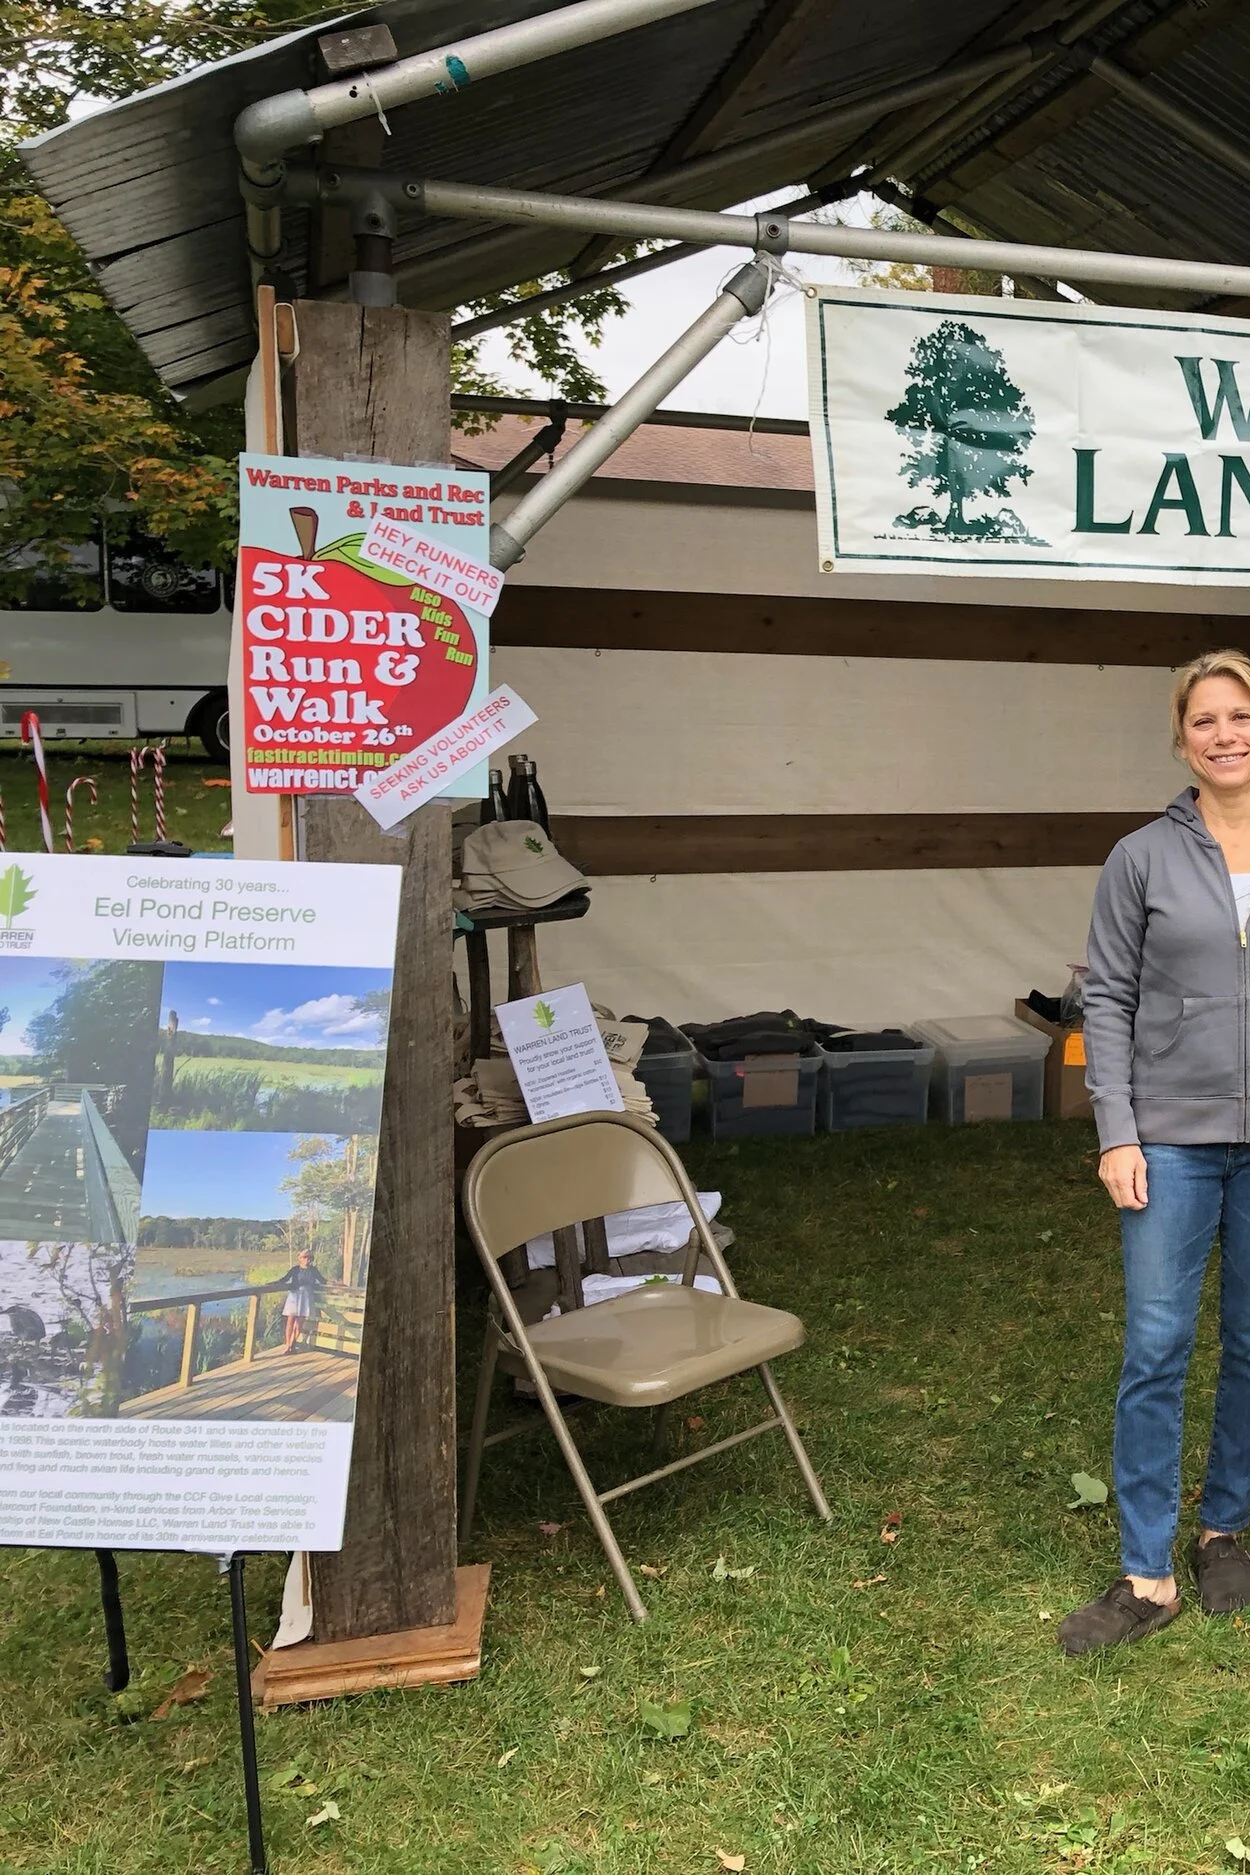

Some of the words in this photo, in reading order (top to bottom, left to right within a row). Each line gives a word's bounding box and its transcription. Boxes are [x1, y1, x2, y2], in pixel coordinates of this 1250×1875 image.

[246, 467, 331, 493] Warren
[336, 475, 398, 498] Parks
[402, 483, 441, 502] and
[448, 485, 485, 504] Rec
[347, 500, 365, 518] &
[428, 507, 485, 526] Trust
[374, 522, 414, 547] HEY
[415, 541, 500, 590] RUNNERS
[252, 562, 331, 600] 5K
[367, 542, 431, 580] CHECK
[434, 572, 452, 588] IT
[455, 582, 492, 606] OUT
[409, 586, 442, 608] Also
[246, 604, 426, 648] CIDER
[421, 606, 453, 627] Kids
[434, 626, 460, 646] Fun
[249, 645, 363, 684] Run
[374, 650, 421, 687] &
[445, 646, 473, 666] Run
[249, 686, 389, 725] Walk
[253, 724, 356, 745] October
[362, 724, 413, 745] 26th
[370, 754, 428, 799] SEEKING
[427, 696, 511, 757] VOLUNTEERS
[400, 776, 429, 801] ASK
[428, 762, 448, 779] US
[449, 728, 492, 765] ABOUT
[493, 718, 506, 733] IT
[126, 876, 210, 893] Celebrating
[215, 879, 234, 891] 30
[237, 880, 289, 895] years...
[94, 897, 131, 918] Eel
[140, 899, 203, 920] Pond
[212, 901, 316, 923] Preserve
[112, 928, 196, 952] Viewing
[204, 931, 295, 951] Platform
[513, 1039, 548, 1055] WARREN
[548, 1033, 569, 1045] LAND
[569, 1024, 594, 1038] TRUST
[12, 1423, 49, 1433] located
[51, 1425, 66, 1433] on
[67, 1424, 83, 1433] the
[86, 1424, 112, 1434] north
[115, 1424, 136, 1434] side
[139, 1425, 149, 1435] of
[152, 1425, 181, 1436] Route
[183, 1426, 203, 1436] 341
[206, 1426, 225, 1436] and
[228, 1428, 248, 1436] was
[251, 1427, 293, 1437] donated
[296, 1427, 308, 1439] by
[311, 1427, 327, 1437] the
[36, 1436, 56, 1445] This
[57, 1437, 91, 1446] scenic
[93, 1438, 146, 1449] waterbody
[148, 1438, 176, 1448] hosts
[179, 1439, 207, 1449] water
[234, 1440, 254, 1449] and
[257, 1440, 282, 1450] other
[286, 1440, 325, 1451] wetland
[10, 1449, 31, 1458] with
[75, 1450, 106, 1460] brown
[139, 1452, 164, 1462] fresh
[166, 1453, 195, 1462] water
[244, 1454, 281, 1463] various
[284, 1454, 323, 1465] species
[16, 1462, 35, 1474] frog
[38, 1463, 57, 1472] and
[60, 1464, 88, 1473] much
[90, 1465, 117, 1474] avian
[136, 1465, 182, 1477] including
[185, 1465, 215, 1477] grand
[218, 1466, 249, 1477] egrets
[251, 1466, 271, 1476] and
[64, 1491, 121, 1502] community
[162, 1518, 199, 1528] Warren
[201, 1519, 227, 1529] Land
[231, 1519, 254, 1529] Trust
